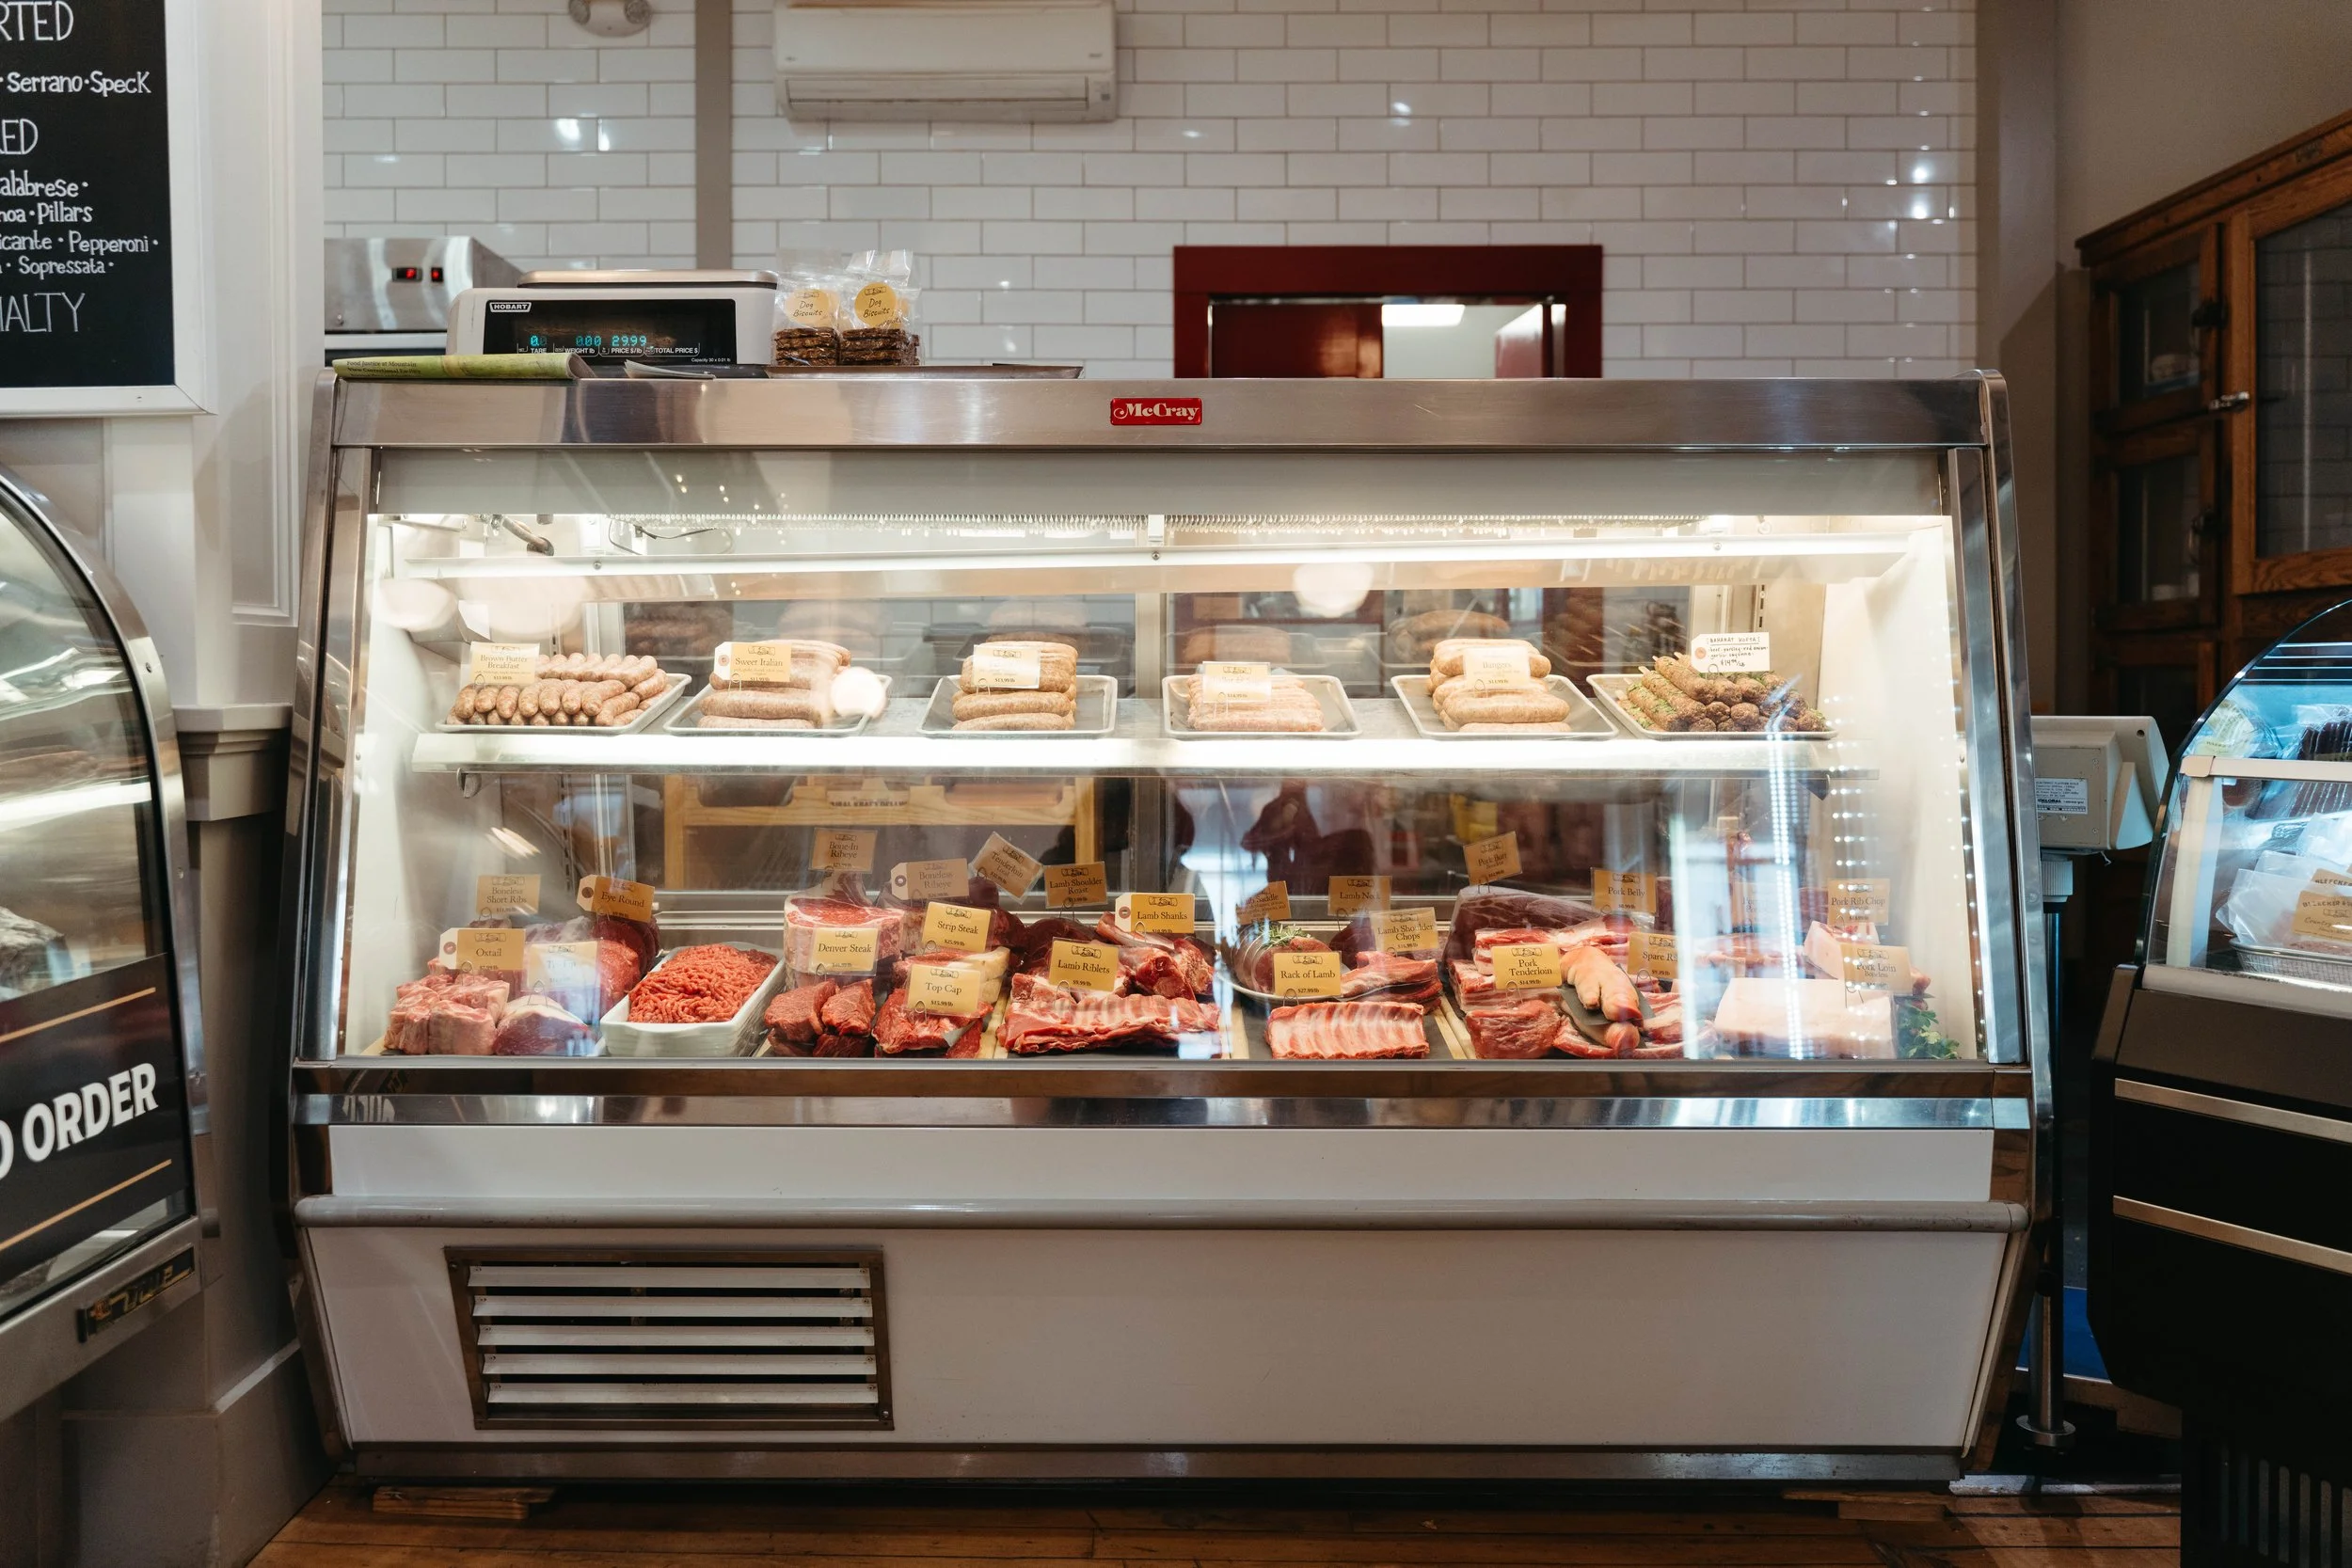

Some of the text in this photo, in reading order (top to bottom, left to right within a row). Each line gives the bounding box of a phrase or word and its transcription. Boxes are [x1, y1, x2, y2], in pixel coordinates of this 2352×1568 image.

[7, 71, 83, 92] Serrano
[0, 119, 39, 154] ED
[37, 200, 93, 225] Pillars
[68, 230, 149, 256] Pepperoni
[18, 255, 105, 280] Sopressata
[799, 301, 814, 309] Dog
[612, 335, 646, 347] 29.99
[1113, 402, 1200, 420] McCray
[481, 654, 504, 662] Brown
[735, 657, 784, 667] Sweet Italian
[830, 848, 858, 859] Ribeye
[992, 850, 1024, 879] Tenderloin
[1049, 877, 1104, 889] Lamb Shoulder
[492, 886, 524, 895] Boneless
[1339, 891, 1381, 900] Lamb Nek
[1607, 886, 1645, 898] Pork Belly
[486, 895, 528, 904] Short Ribs
[600, 891, 645, 908] Eye Round
[1256, 893, 1279, 903] Saddle
[1831, 896, 1849, 906] Pork
[1851, 896, 1864, 905] Rib
[1865, 896, 1886, 908] Chop
[1136, 911, 1188, 920] Lamb Shanks
[937, 920, 979, 935] Strip Steak
[1377, 926, 1400, 935] Lamb
[1395, 932, 1421, 942] Chops
[475, 947, 502, 957] Oxtail
[818, 942, 872, 953] Denver Steak
[1642, 950, 1664, 961] Spare
[1057, 958, 1110, 974] Lamb Riblets
[1518, 958, 1538, 967] Pork
[1856, 961, 1897, 973] Pork Loin
[1280, 969, 1336, 979] Rack of Lamb
[1508, 966, 1552, 976] Tenderloin
[925, 982, 962, 995] Top Cap
[22, 1062, 159, 1163] ORDER
